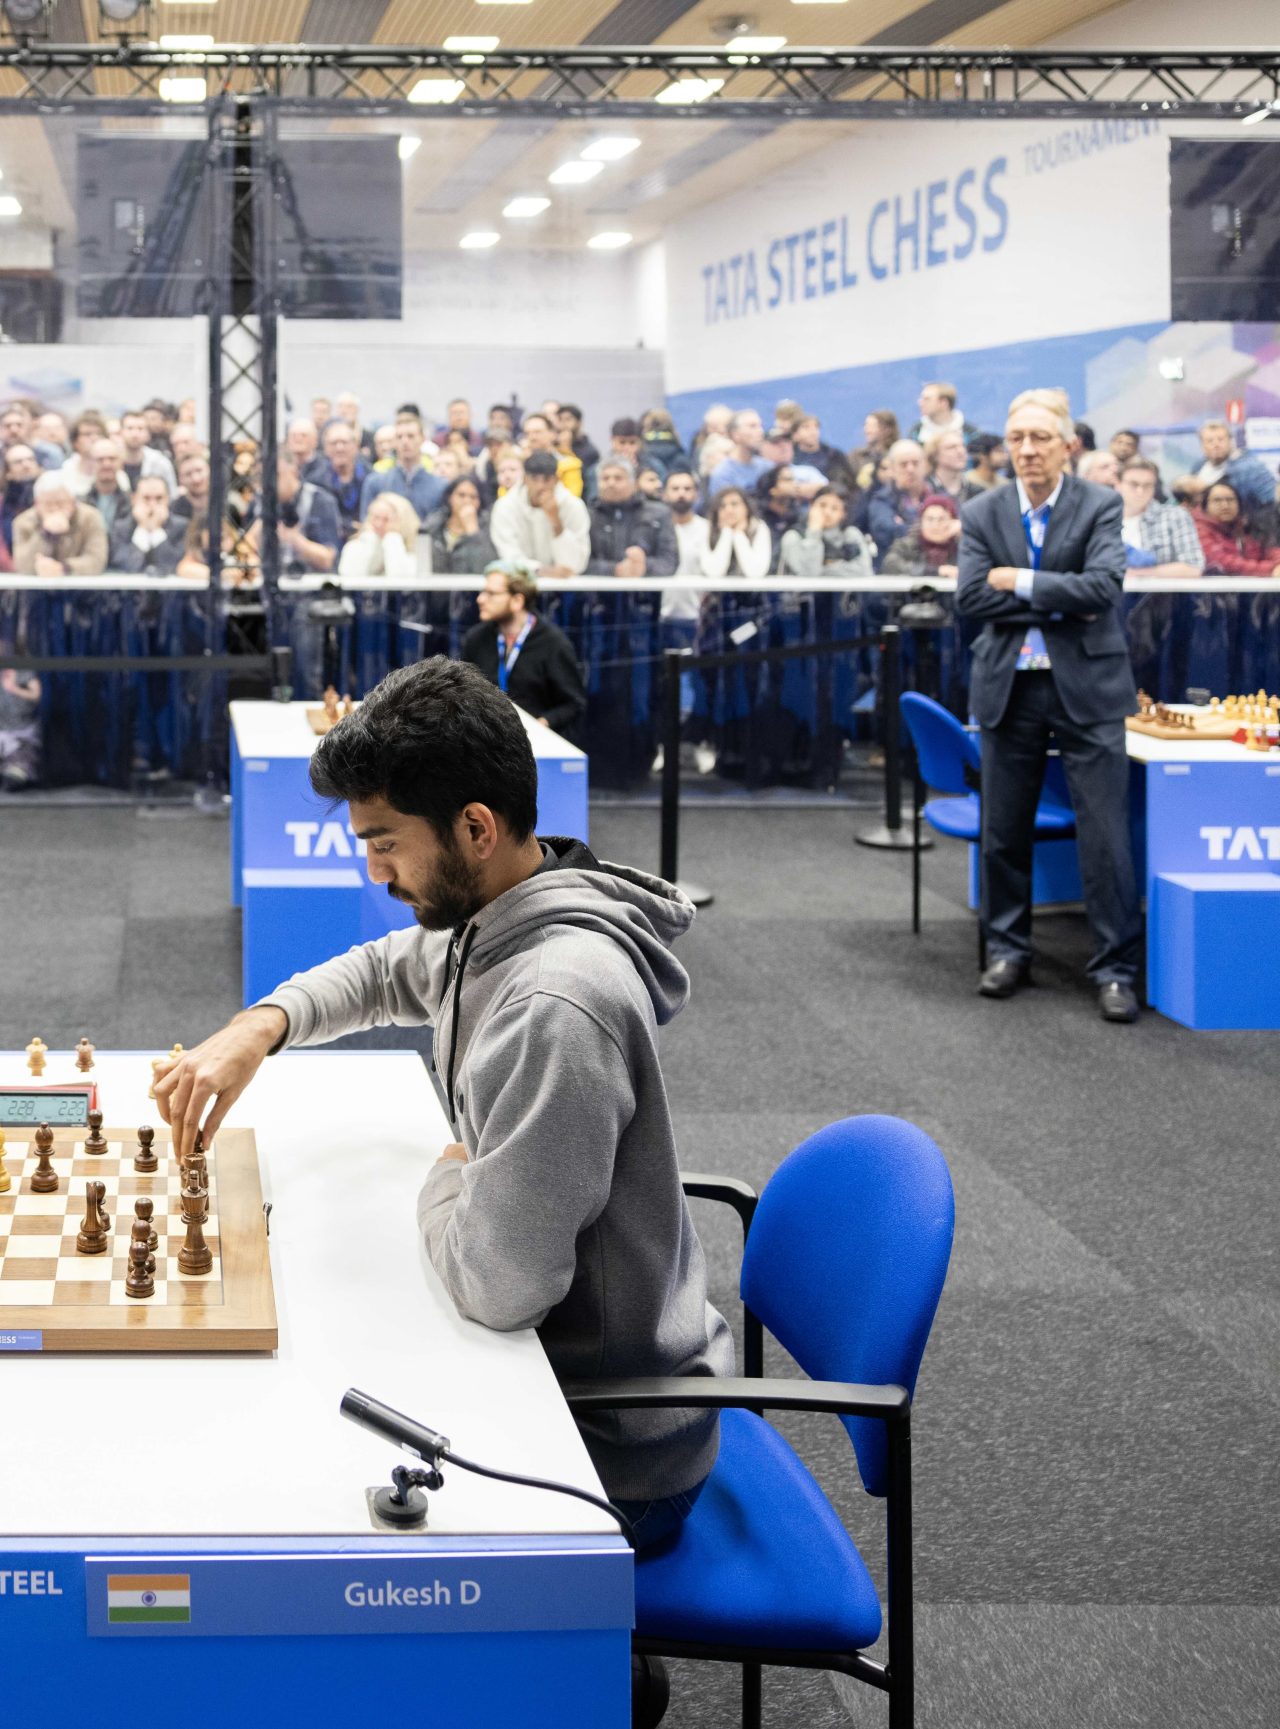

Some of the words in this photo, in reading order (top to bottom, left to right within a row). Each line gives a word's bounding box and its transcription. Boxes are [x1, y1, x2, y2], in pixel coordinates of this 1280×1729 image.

[701, 248, 761, 326] TATA
[766, 215, 858, 308] STEEL
[867, 156, 1008, 282] CHESS
[344, 1580, 451, 1607] Gukesh
[460, 1580, 481, 1605] D
